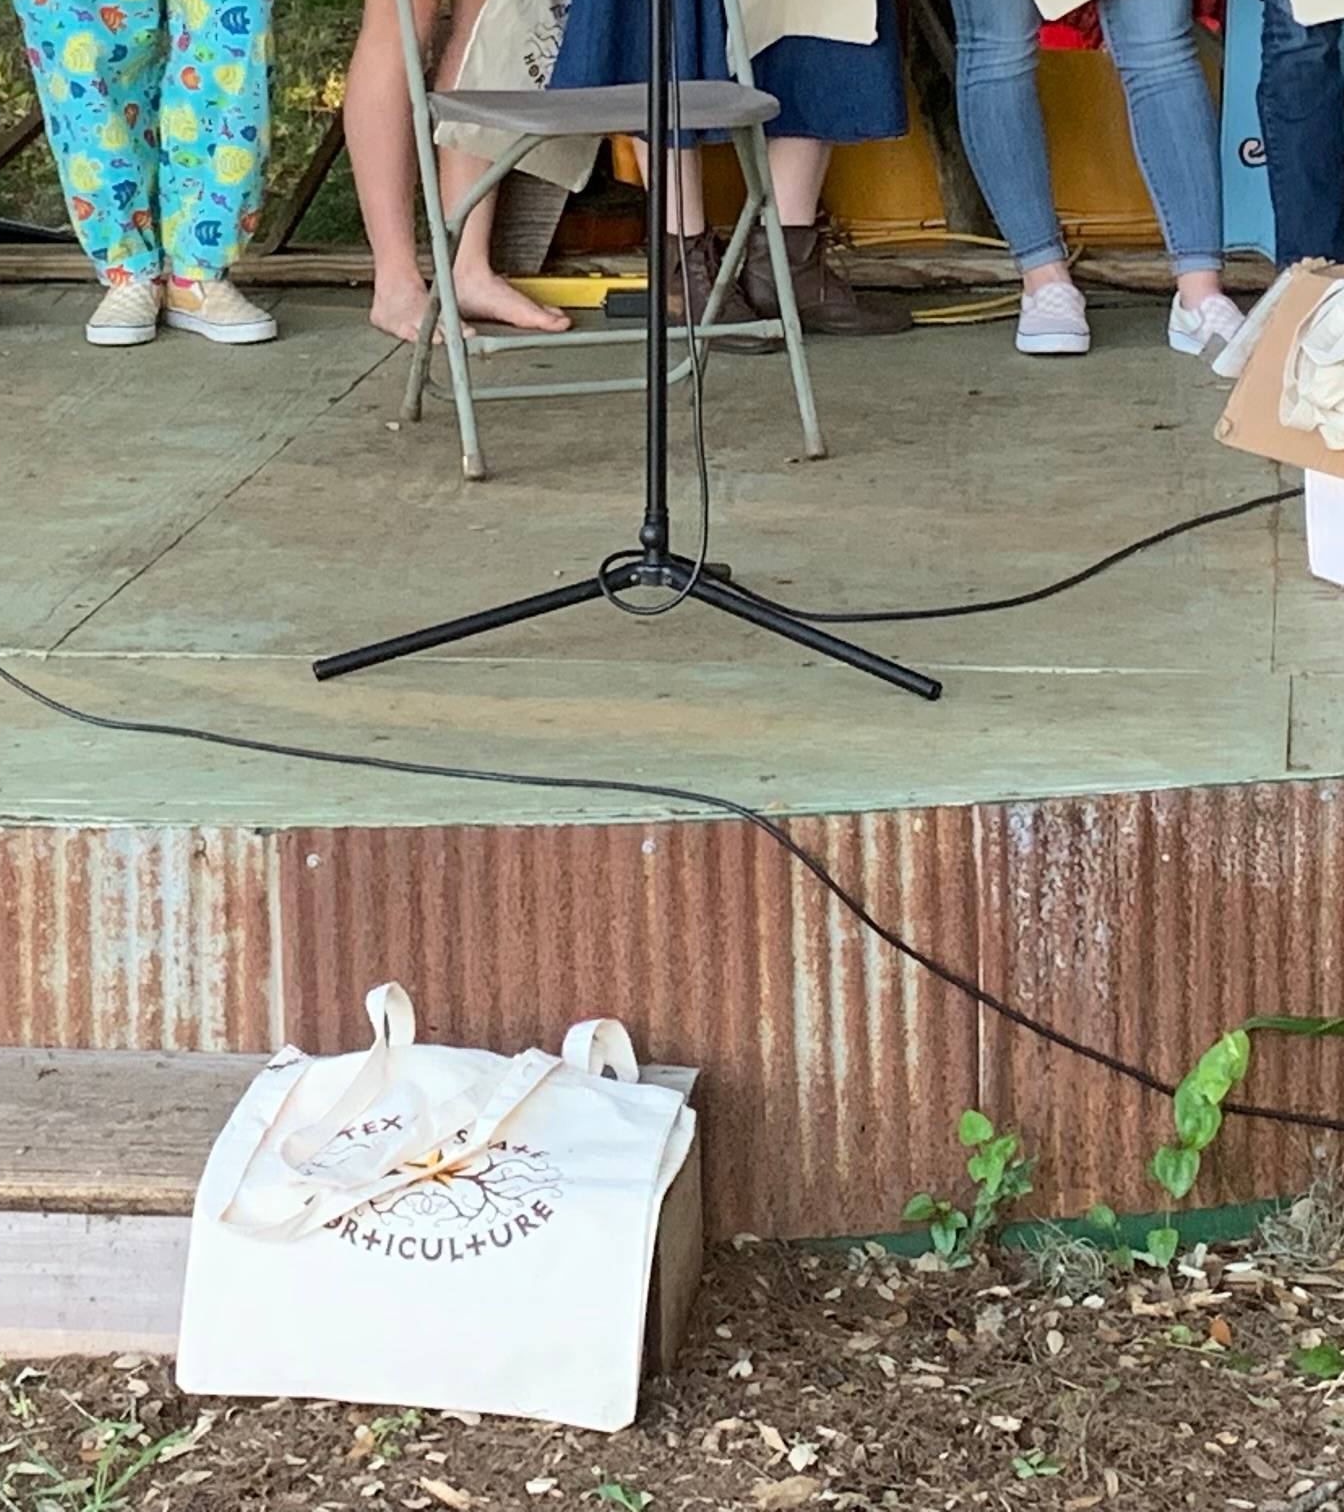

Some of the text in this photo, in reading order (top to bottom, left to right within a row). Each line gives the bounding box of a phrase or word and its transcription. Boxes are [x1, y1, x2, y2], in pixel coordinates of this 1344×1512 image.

[336, 1114, 551, 1160] TEX SATE
[304, 1194, 555, 1263] RTICULTURE
